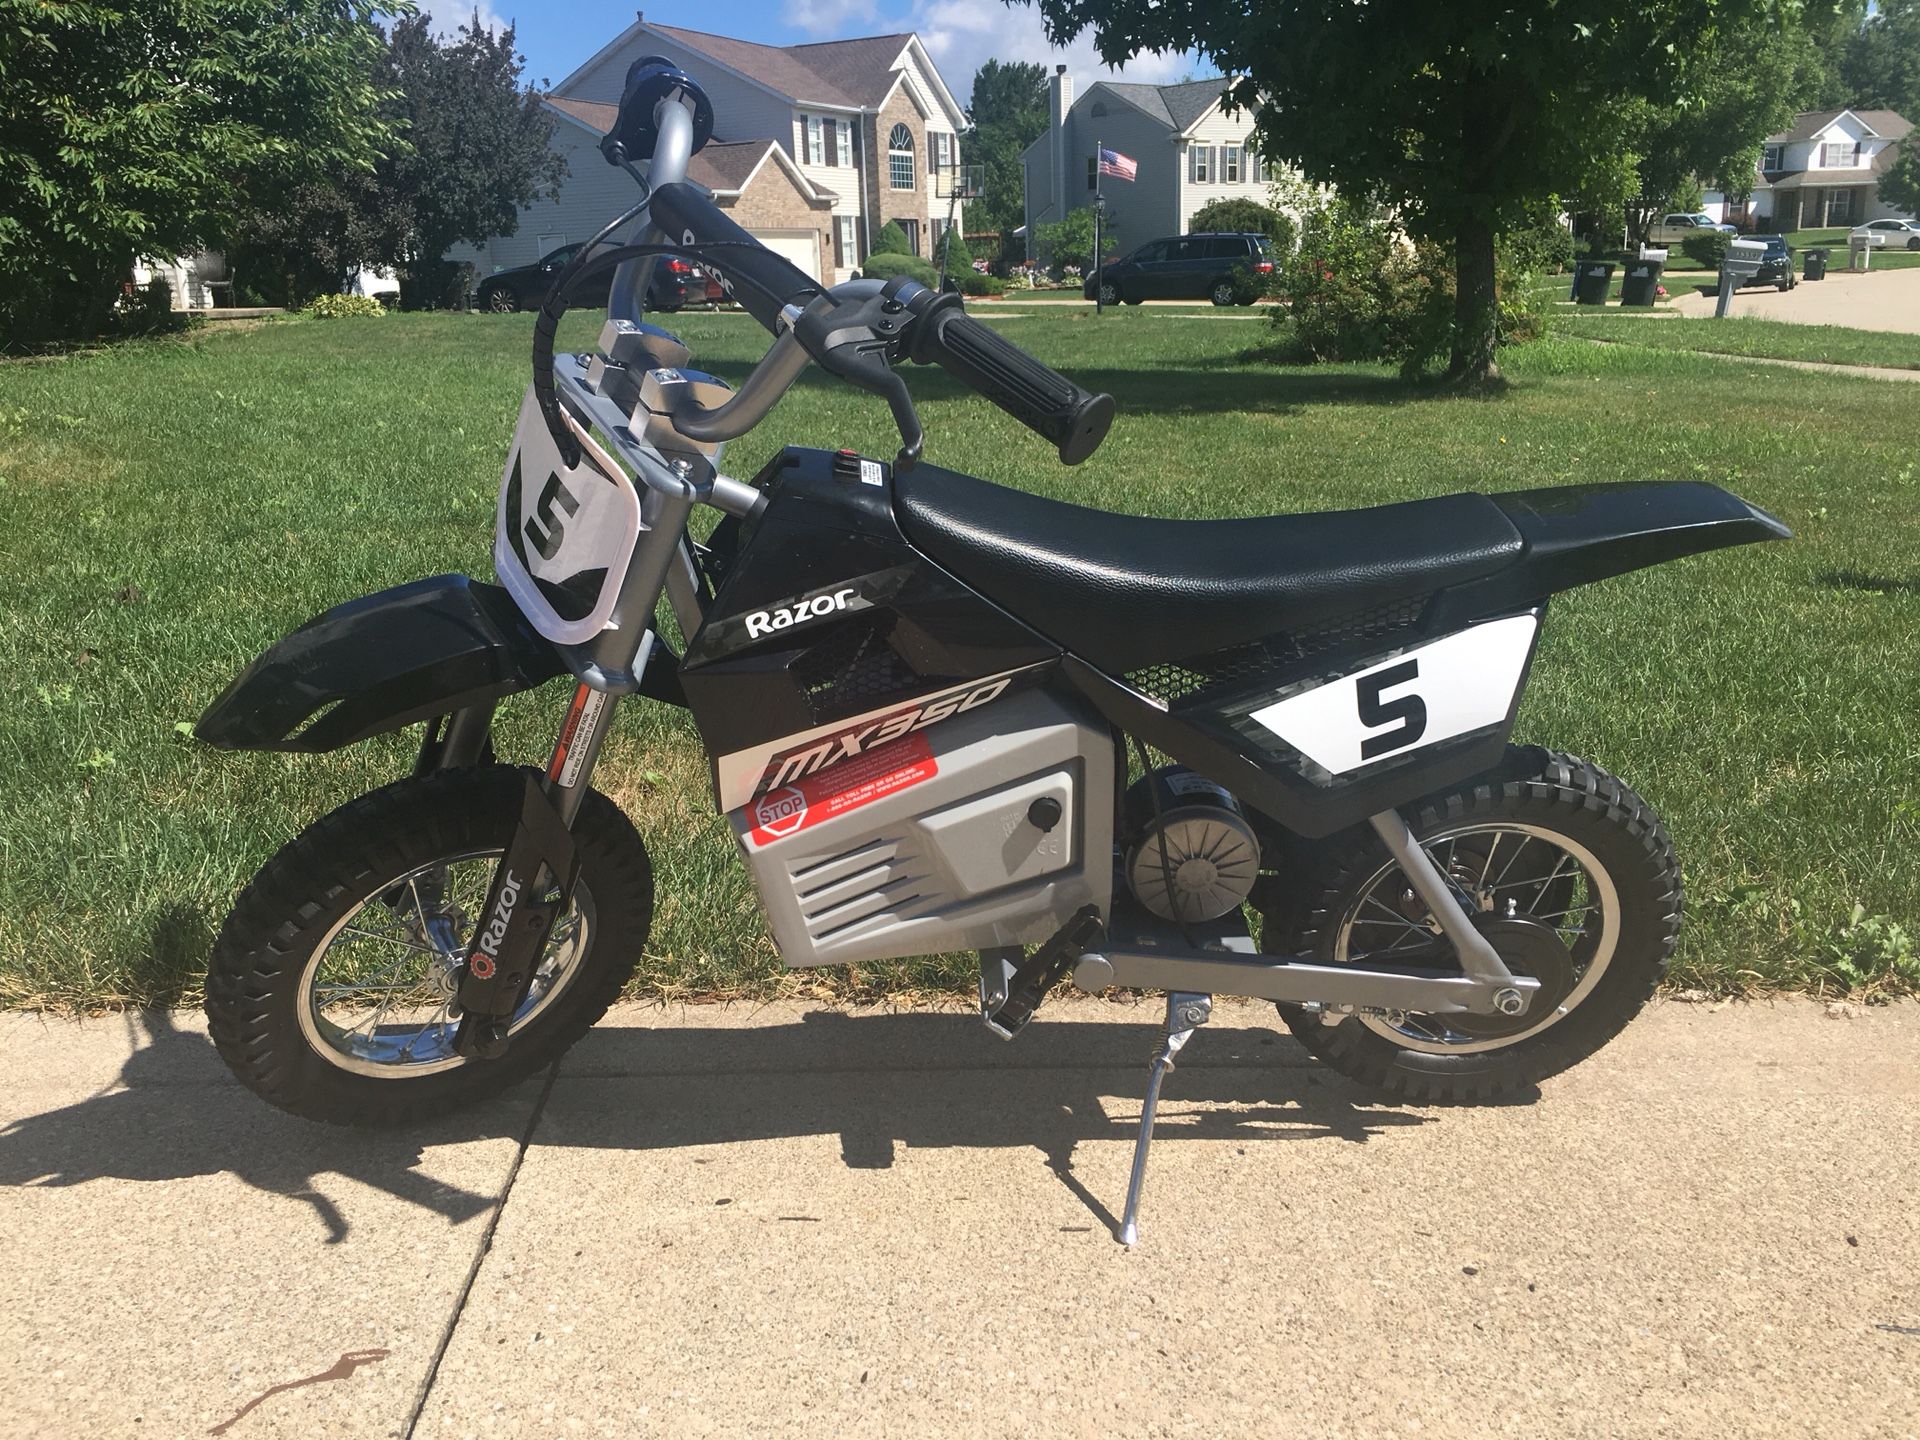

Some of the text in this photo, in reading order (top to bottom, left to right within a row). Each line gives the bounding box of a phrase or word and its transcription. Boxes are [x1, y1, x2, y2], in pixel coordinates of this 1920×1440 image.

[523, 470, 581, 561] 5
[745, 588, 855, 639] Razor
[766, 678, 1011, 792] MX350
[1355, 657, 1427, 761] 5
[760, 797, 803, 824] STOP
[480, 869, 521, 956] Razor
